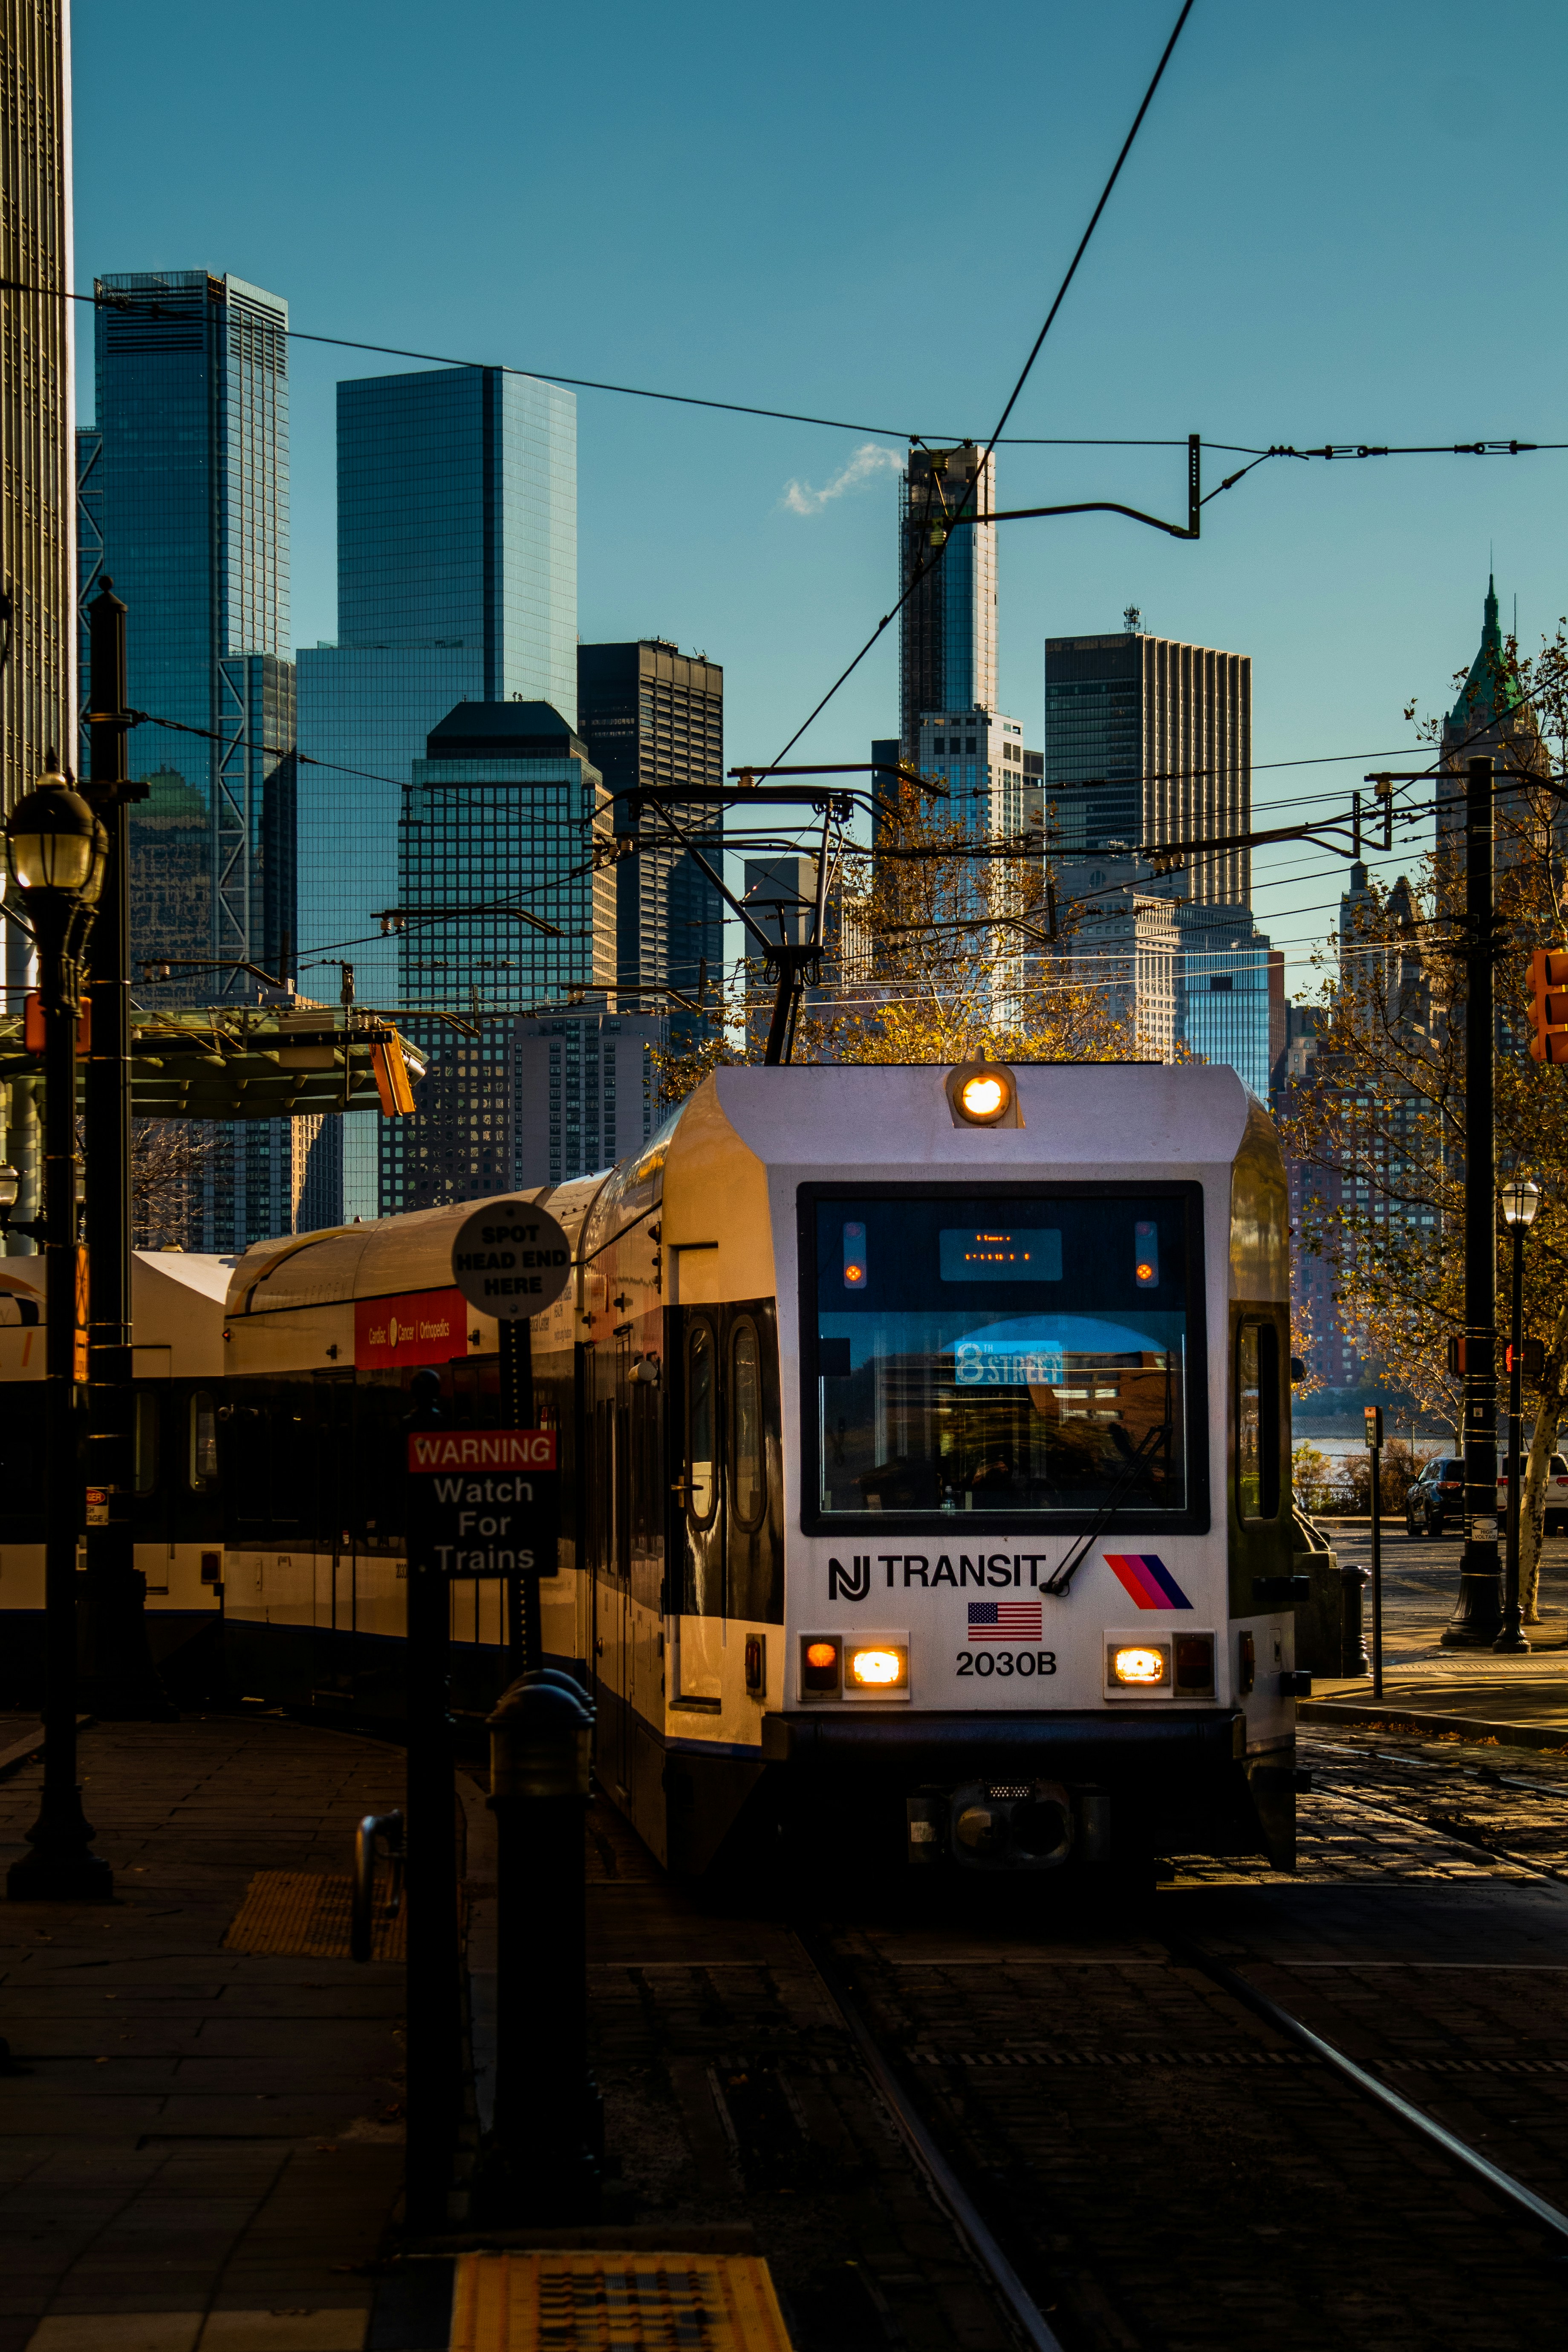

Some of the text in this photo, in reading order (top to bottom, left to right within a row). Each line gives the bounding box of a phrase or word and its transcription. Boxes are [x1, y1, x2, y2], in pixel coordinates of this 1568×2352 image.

[482, 1225, 539, 1244] SPOT
[457, 1250, 566, 1270] HEAD END
[485, 1277, 542, 1295] HERE
[398, 1323, 414, 1341] Cancer
[420, 1318, 449, 1341] Orthopedics
[988, 1355, 1060, 1382] STREET
[414, 1437, 551, 1465] WARNING
[433, 1476, 534, 1503] Watch
[458, 1510, 512, 1537] For
[433, 1543, 535, 1572] Trains
[828, 1554, 1046, 1601] NJ TRANSIT
[956, 1651, 1057, 1676] 2030B
